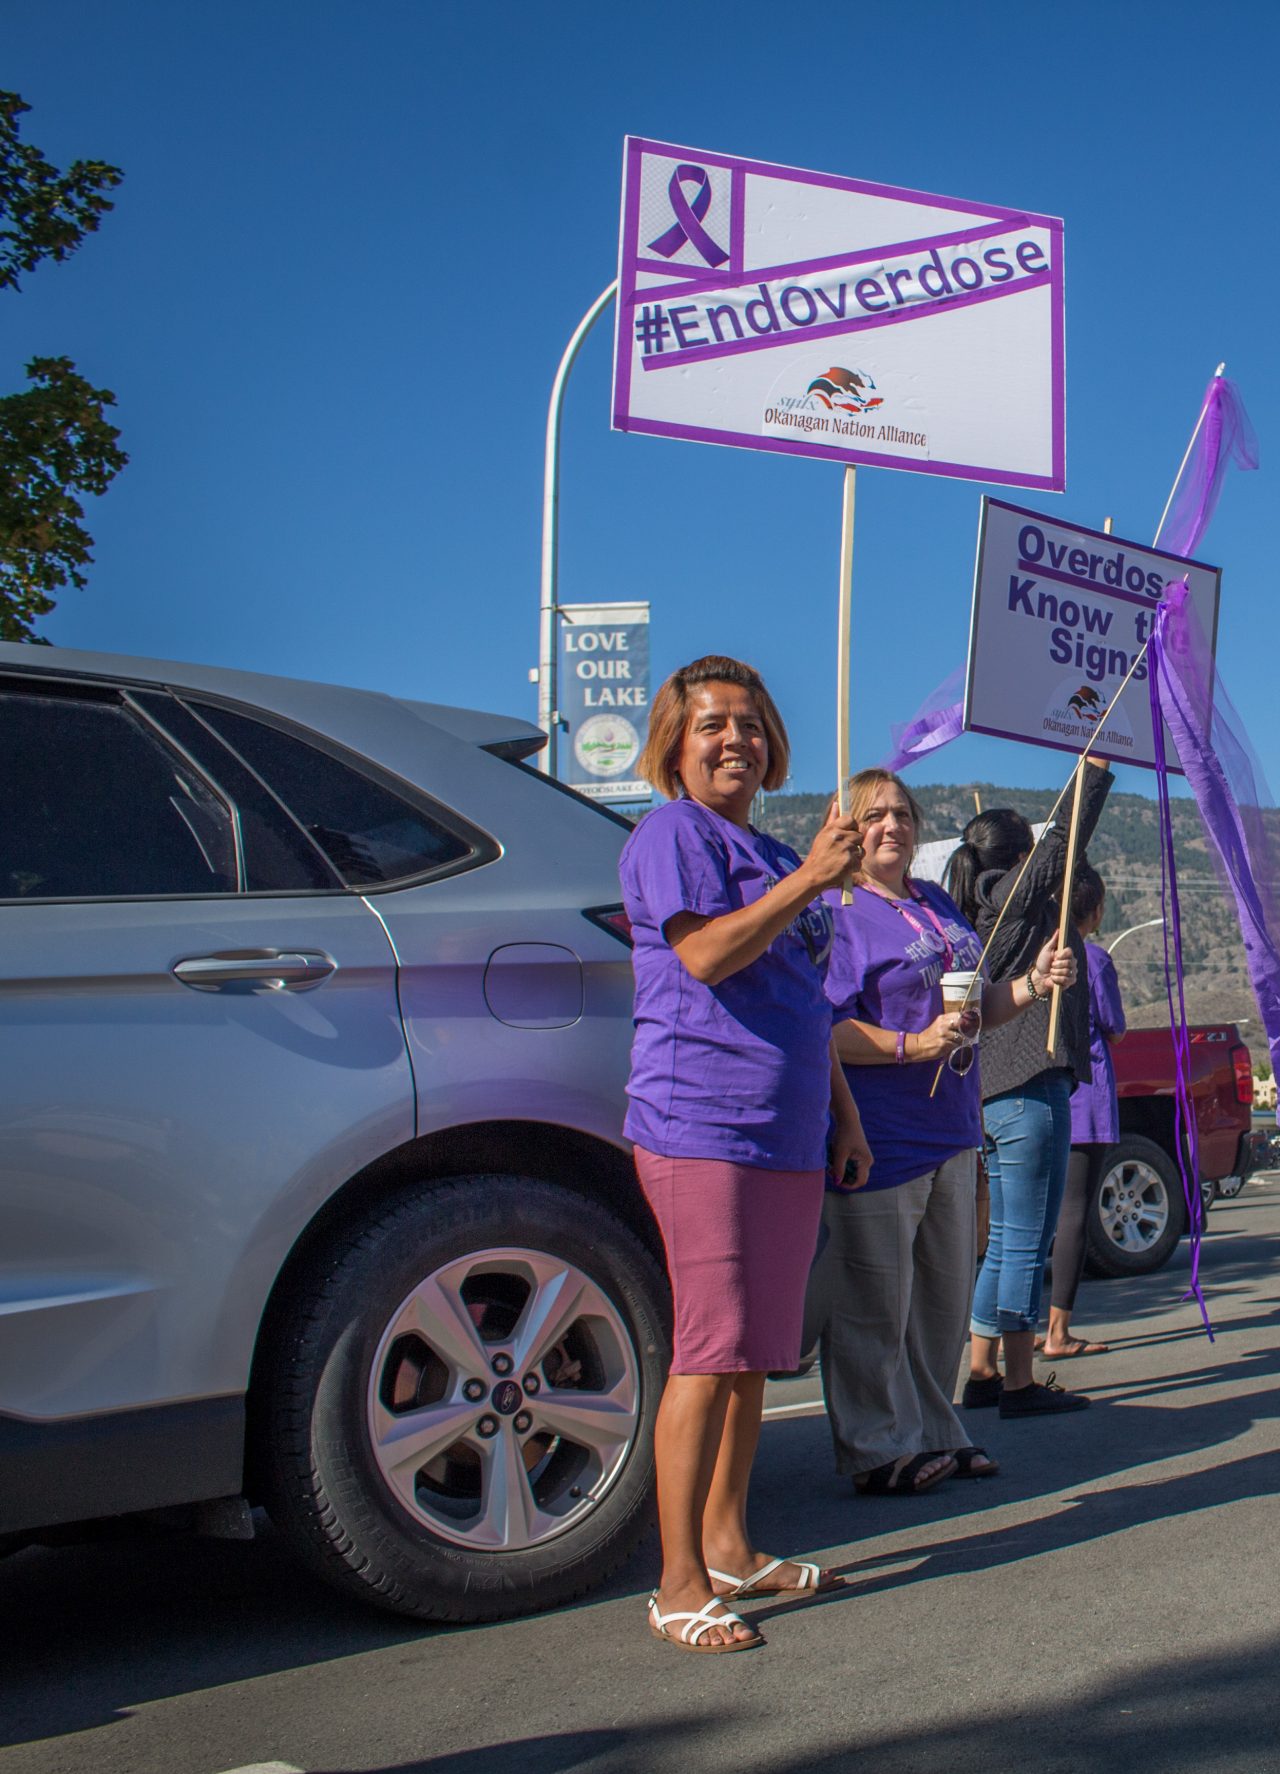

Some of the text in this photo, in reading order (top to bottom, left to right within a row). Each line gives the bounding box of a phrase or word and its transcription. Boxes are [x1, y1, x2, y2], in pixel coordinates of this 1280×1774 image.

[635, 240, 1049, 354] #EndOverdose
[764, 408, 926, 447] Okanagan Nation Alliance
[1008, 575, 1114, 636] Know
[565, 632, 630, 653] LOVE
[1050, 627, 1148, 682] Signs
[576, 660, 632, 680] OUR
[584, 687, 648, 707] LAKE
[1043, 718, 1134, 747] Okanagan Naton Alliance
